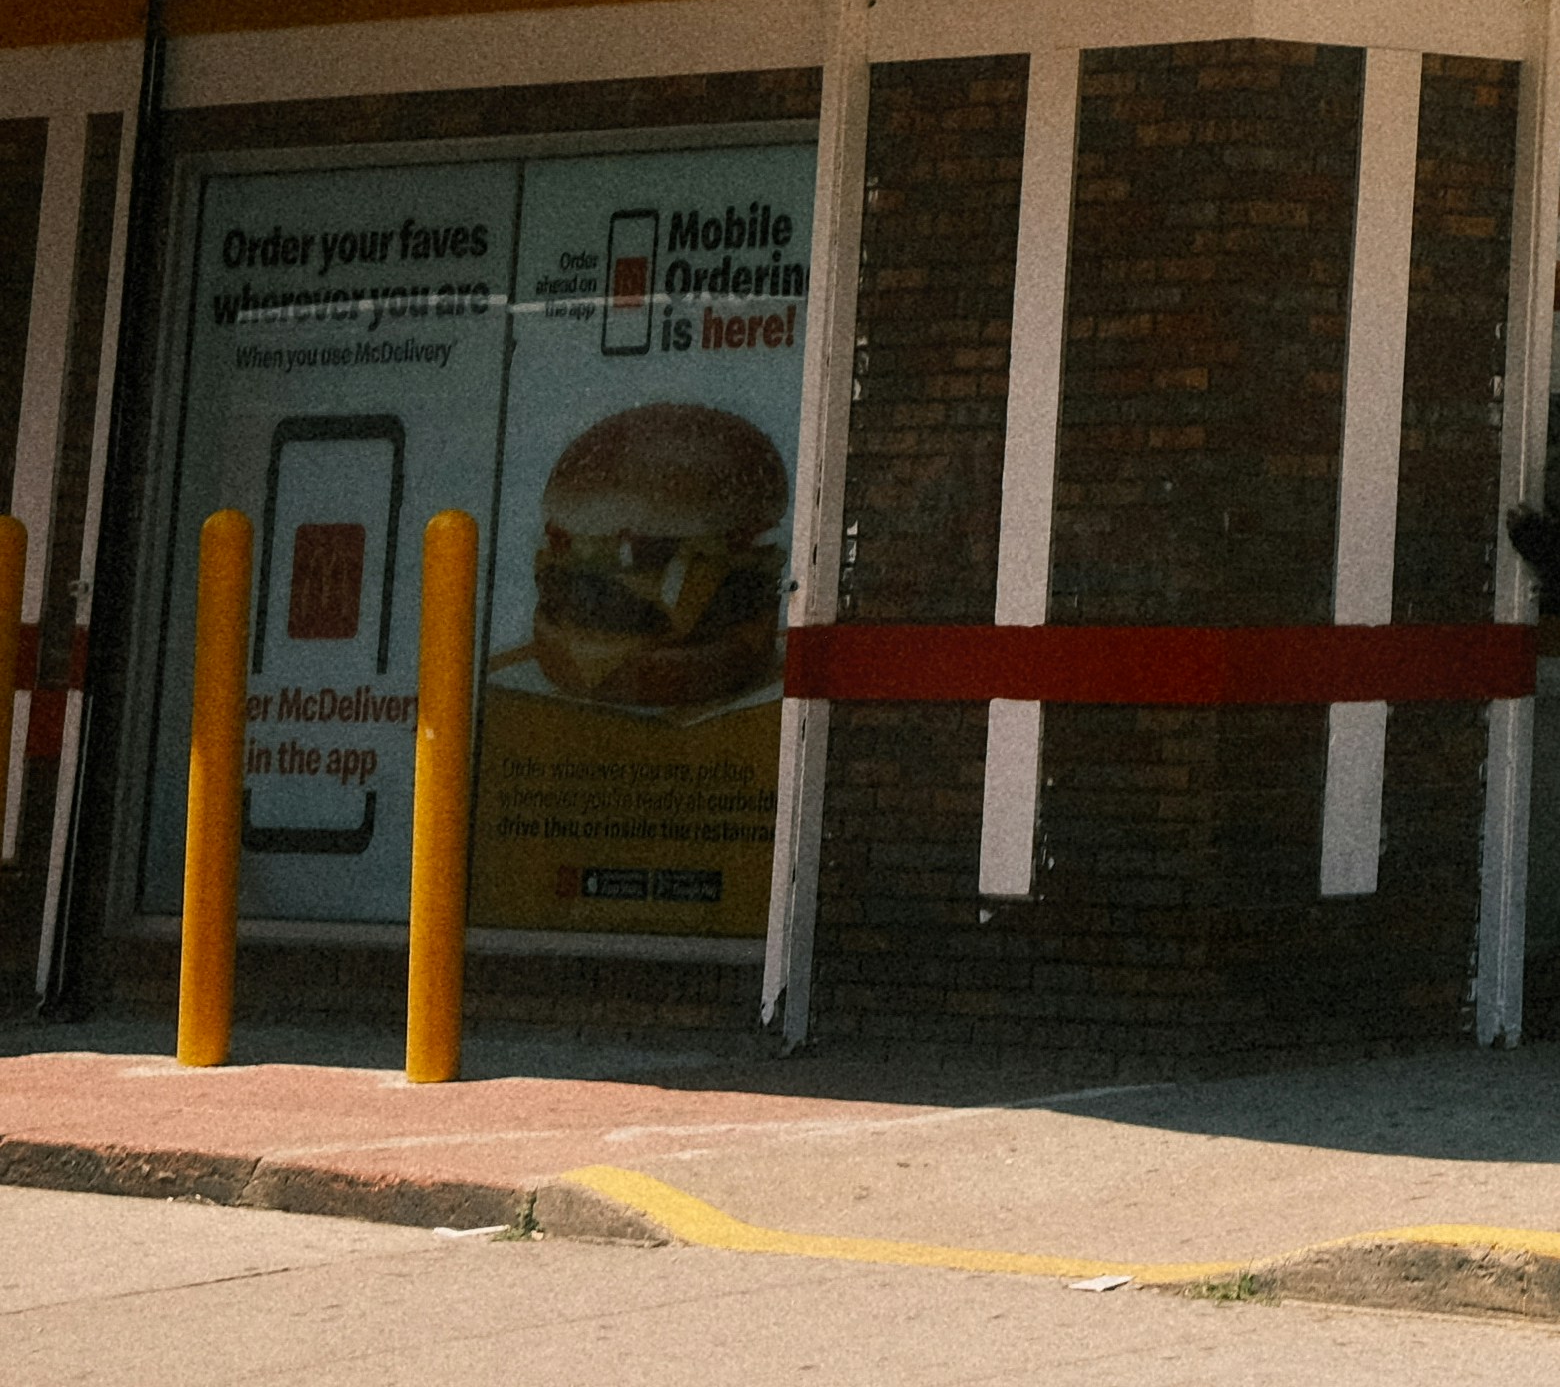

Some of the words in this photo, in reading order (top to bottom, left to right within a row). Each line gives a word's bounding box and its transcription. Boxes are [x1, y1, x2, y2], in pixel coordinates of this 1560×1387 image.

[222, 225, 315, 268] Order
[318, 228, 394, 277] your
[399, 218, 490, 260] faves
[666, 200, 794, 253] Mobile
[559, 250, 599, 270] Order
[664, 249, 811, 297] Orderin
[213, 282, 359, 325] wherever
[660, 306, 693, 352] is
[701, 304, 797, 350] here!
[236, 344, 281, 369] When
[287, 346, 319, 373] you
[249, 737, 272, 775] in
[276, 740, 322, 776] the
[326, 747, 378, 786] app
[693, 820, 776, 842] restaura
